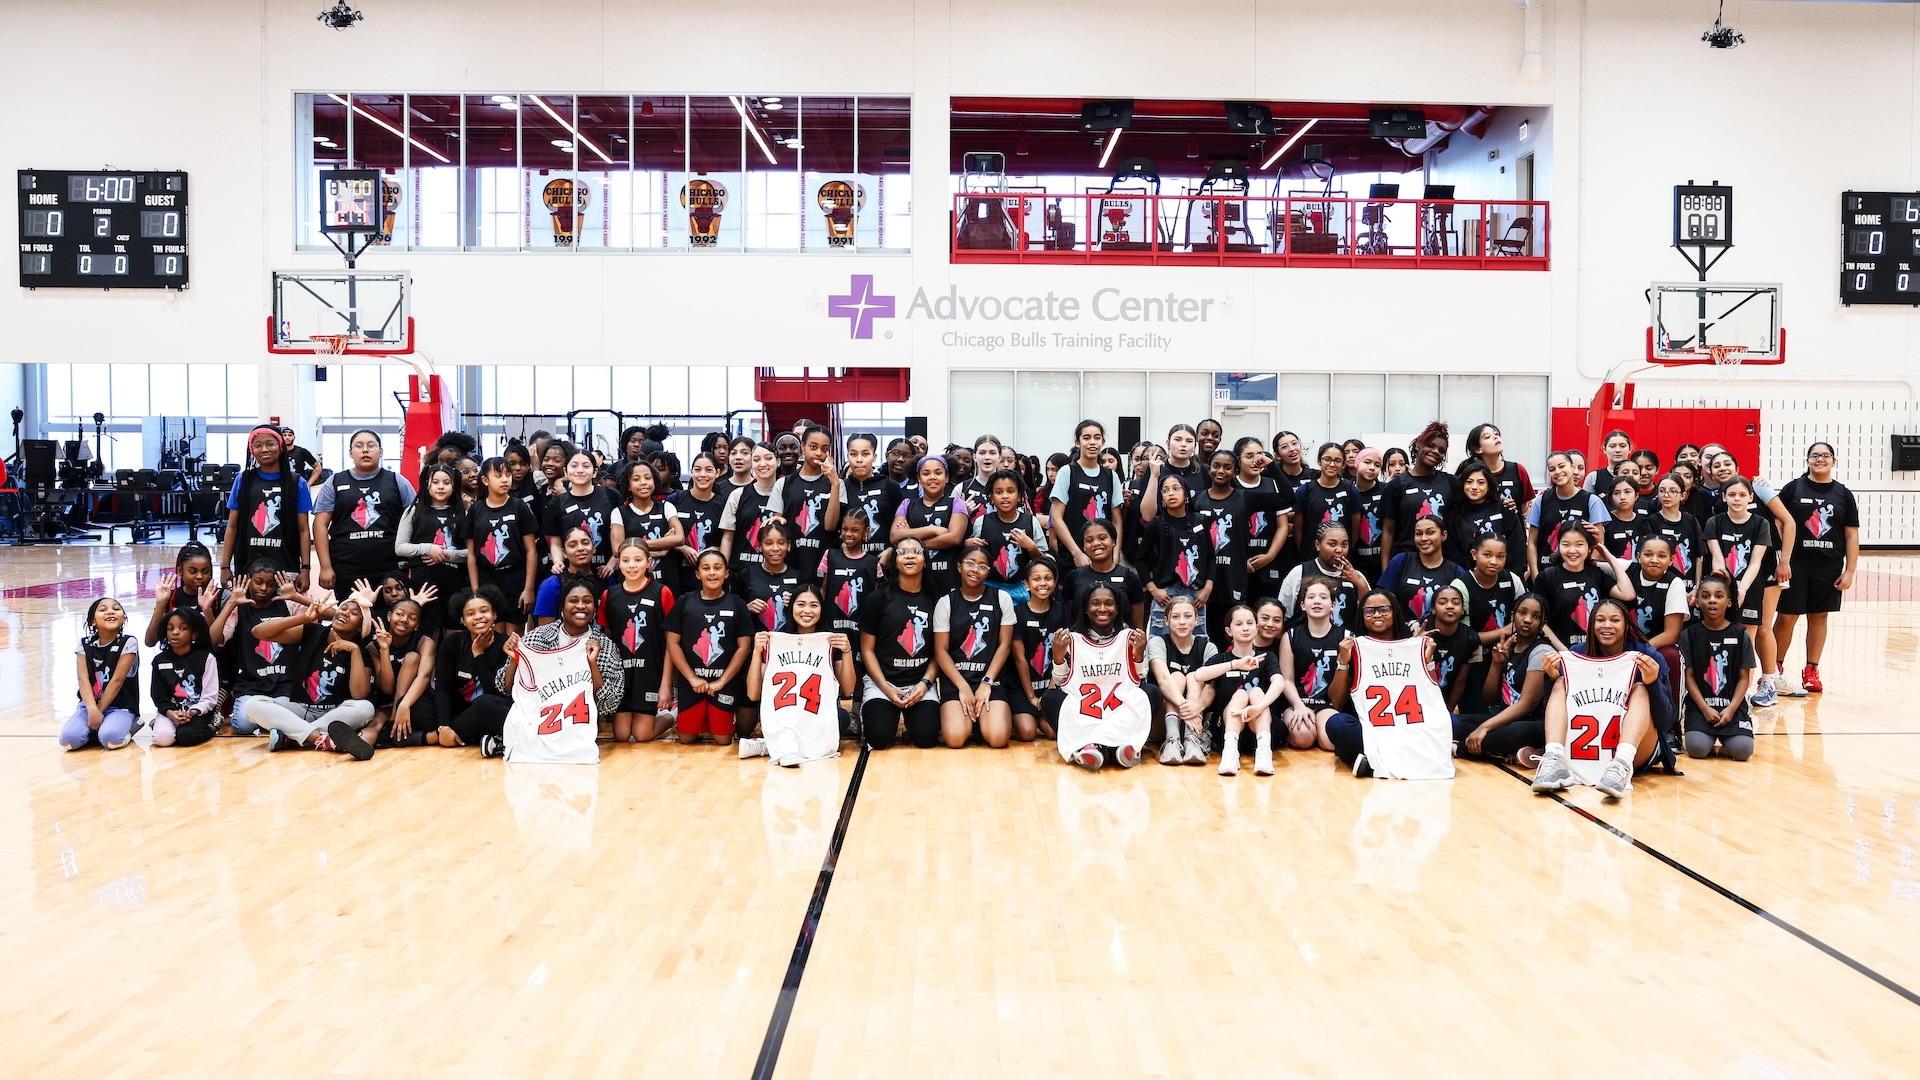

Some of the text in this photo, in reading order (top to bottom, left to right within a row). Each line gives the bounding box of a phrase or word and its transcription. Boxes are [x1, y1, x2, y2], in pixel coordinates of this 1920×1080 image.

[86, 178, 133, 201] 6:00
[30, 194, 58, 205] HOME
[145, 195, 175, 206] GUEST
[47, 212, 61, 235] 0
[98, 218, 108, 235] 2
[163, 213, 178, 236] 0
[1855, 215, 1881, 225] HOME
[554, 235, 580, 243] 199
[1869, 231, 1883, 254] 0
[33, 244, 53, 252] FOULS
[41, 257, 45, 272] 1
[80, 256, 91, 273] 0
[115, 256, 126, 273] 0
[166, 257, 176, 274] 0
[1856, 274, 1866, 290] 0
[1898, 274, 1908, 290] 0
[905, 284, 1214, 322] Advocate Center
[942, 331, 1171, 352] Chicago Bulls Training Facility
[1216, 390, 1228, 399] EXIT
[778, 651, 823, 668] MILLAN
[894, 658, 906, 667] GIRLS
[906, 659, 914, 667] DAY
[1081, 662, 1122, 677] HARPER
[1372, 662, 1411, 678] BAUER
[772, 671, 821, 714] 24
[538, 690, 589, 735] 24
[1366, 685, 1424, 727] 24
[1571, 715, 1620, 760] 24
